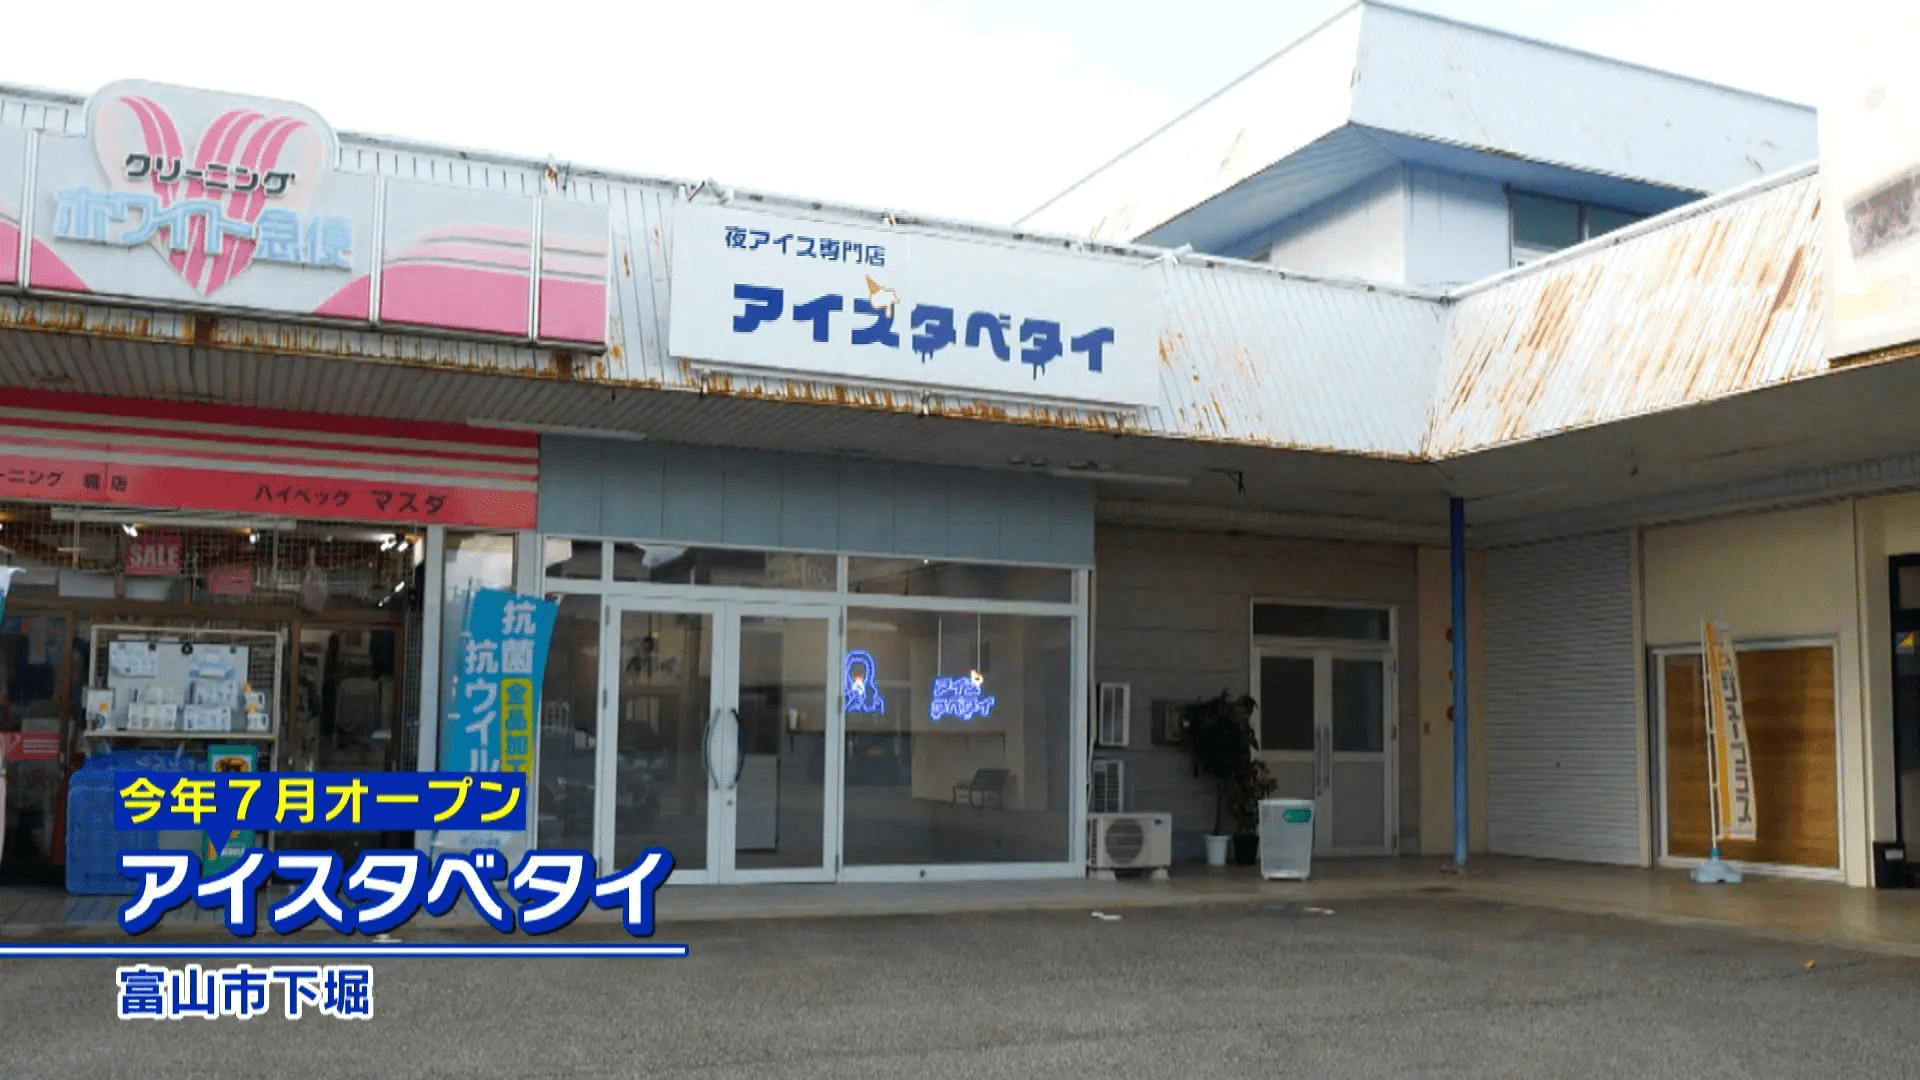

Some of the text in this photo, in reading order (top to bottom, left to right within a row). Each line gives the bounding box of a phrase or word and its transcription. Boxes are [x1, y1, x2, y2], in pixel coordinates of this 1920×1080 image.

[124, 152, 296, 195] クリーニング
[54, 184, 354, 270] ホワイト急便
[724, 225, 886, 267] 夜アイス専門店
[732, 283, 1115, 380] アイスタベタイ
[129, 543, 178, 567] SALE
[502, 601, 536, 674] 抗菌
